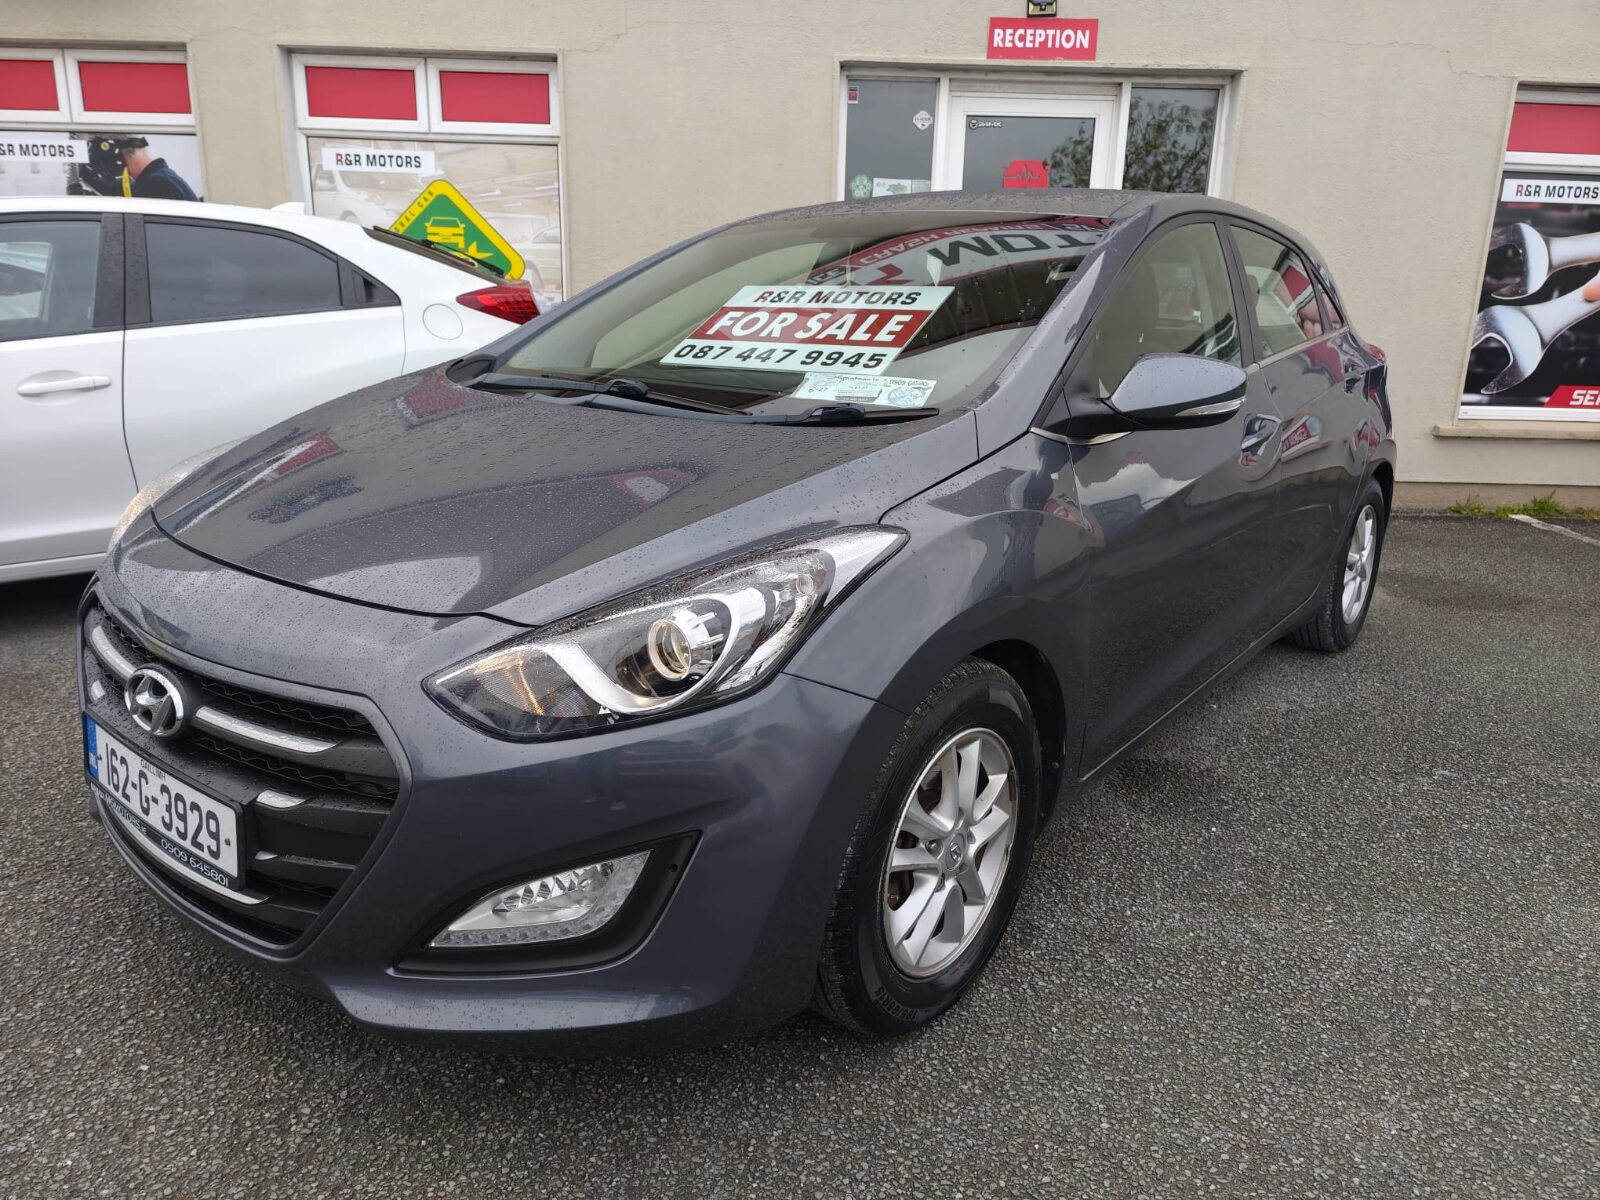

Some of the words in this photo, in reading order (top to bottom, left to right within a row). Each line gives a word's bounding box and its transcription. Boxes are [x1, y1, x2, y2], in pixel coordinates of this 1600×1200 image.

[993, 28, 1090, 49] RECEPTION
[19, 144, 75, 158] MOTORS
[335, 153, 362, 167] R&R
[365, 154, 422, 169] MOTORS
[1515, 183, 1541, 198] R&R
[1545, 184, 1599, 200] MOTORS
[753, 290, 807, 303] R&R
[808, 291, 922, 306] MOTORS
[705, 311, 798, 338] FOR
[795, 312, 914, 342] SALE
[673, 344, 730, 359] 087
[735, 348, 798, 364] 447
[800, 350, 887, 369] 9945
[105, 742, 221, 861] 162-G-3929
[160, 838, 188, 862] 0909
[189, 857, 229, 888] 645801
